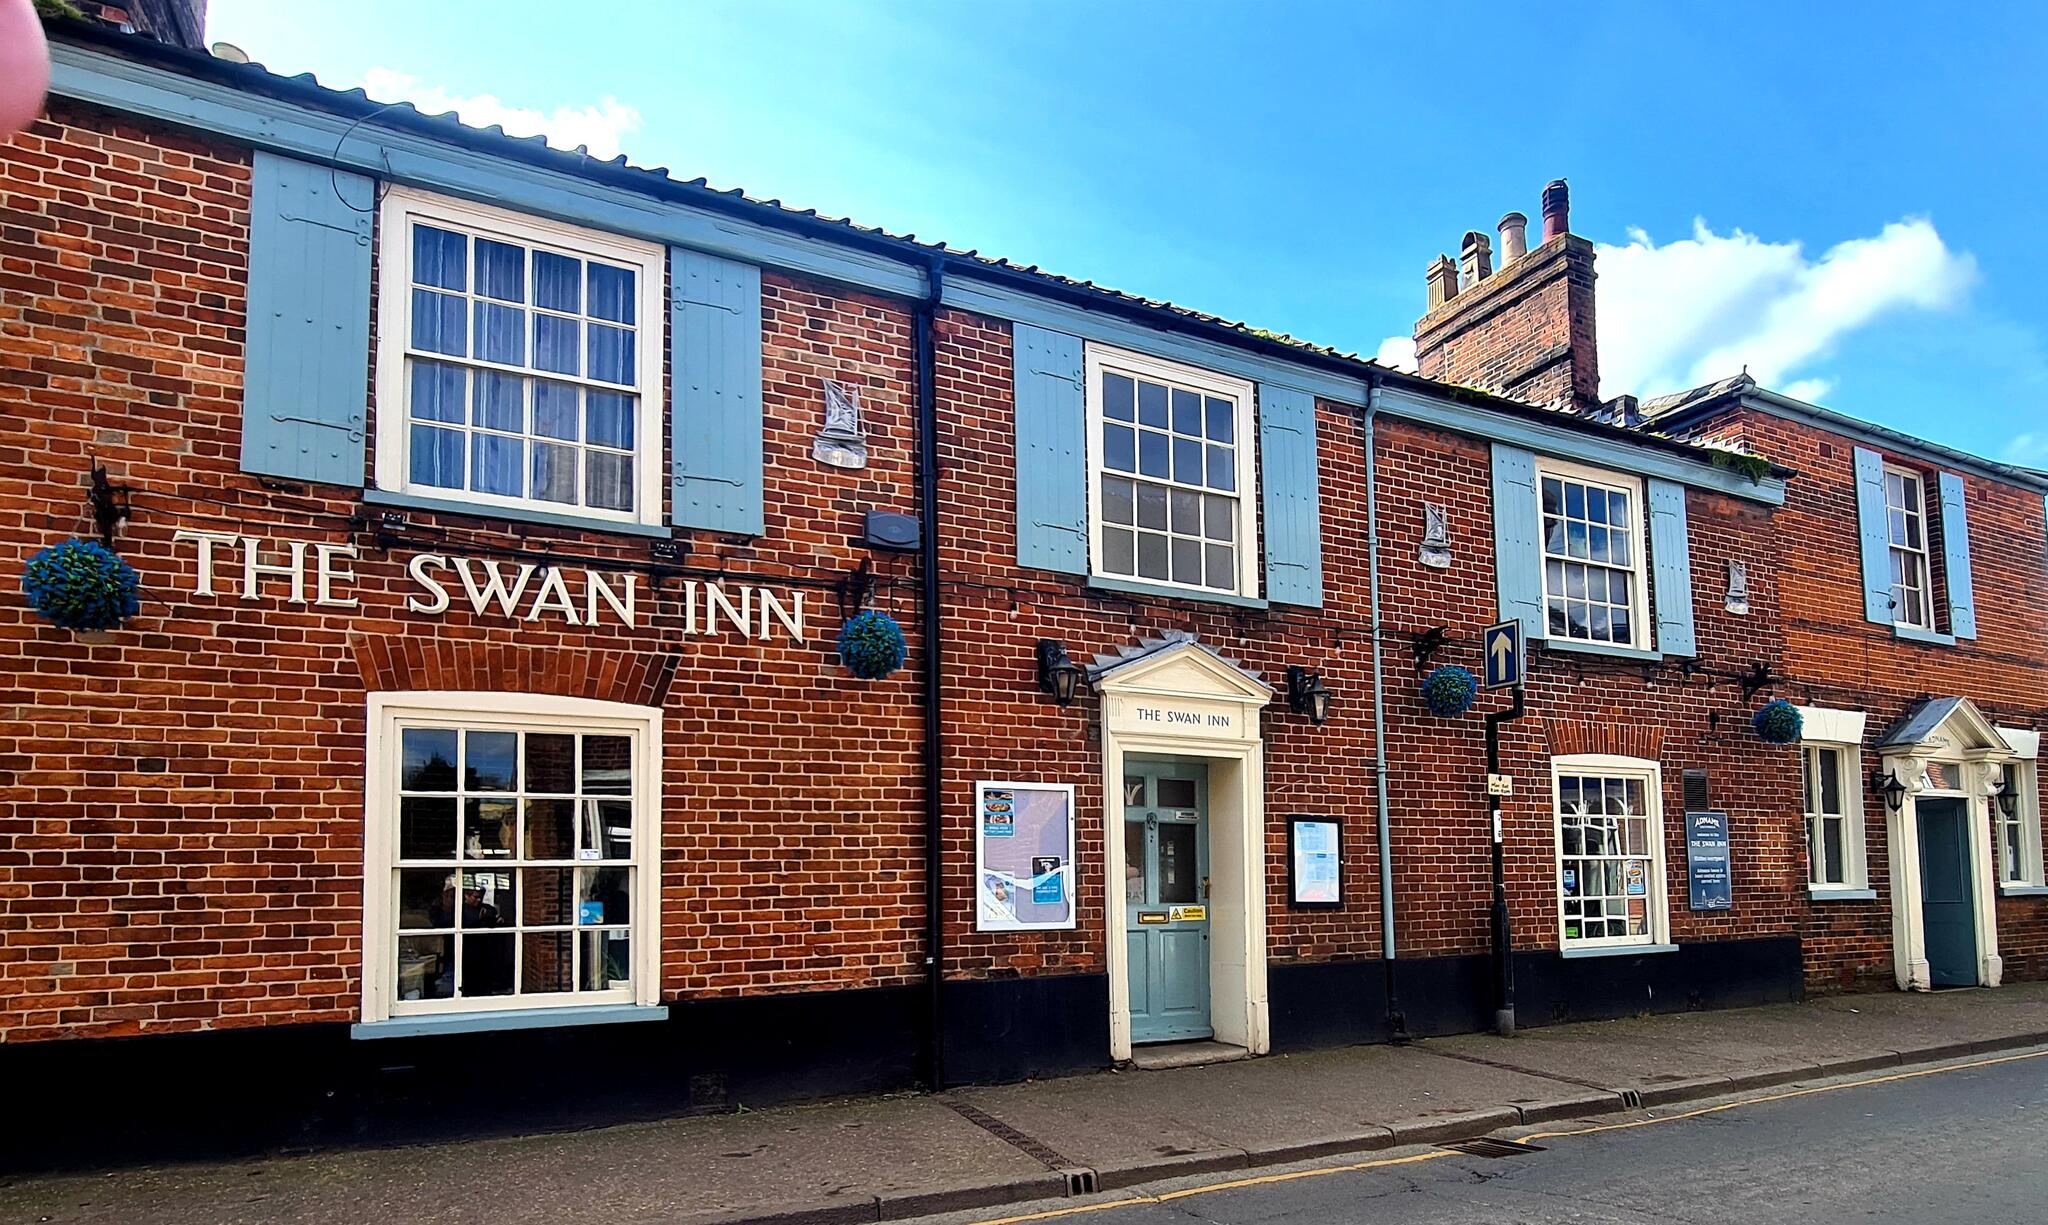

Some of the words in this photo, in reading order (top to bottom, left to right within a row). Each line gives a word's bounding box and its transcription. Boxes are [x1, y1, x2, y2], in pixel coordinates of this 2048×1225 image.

[173, 529, 359, 609] THE
[408, 554, 637, 631] SWAN
[683, 579, 806, 645] INN
[1136, 708, 1161, 722] THE
[1167, 711, 1201, 725] SWAN
[1207, 714, 1230, 728] INN
[1690, 840, 1701, 848] THE
[1701, 840, 1716, 849] SWAN
